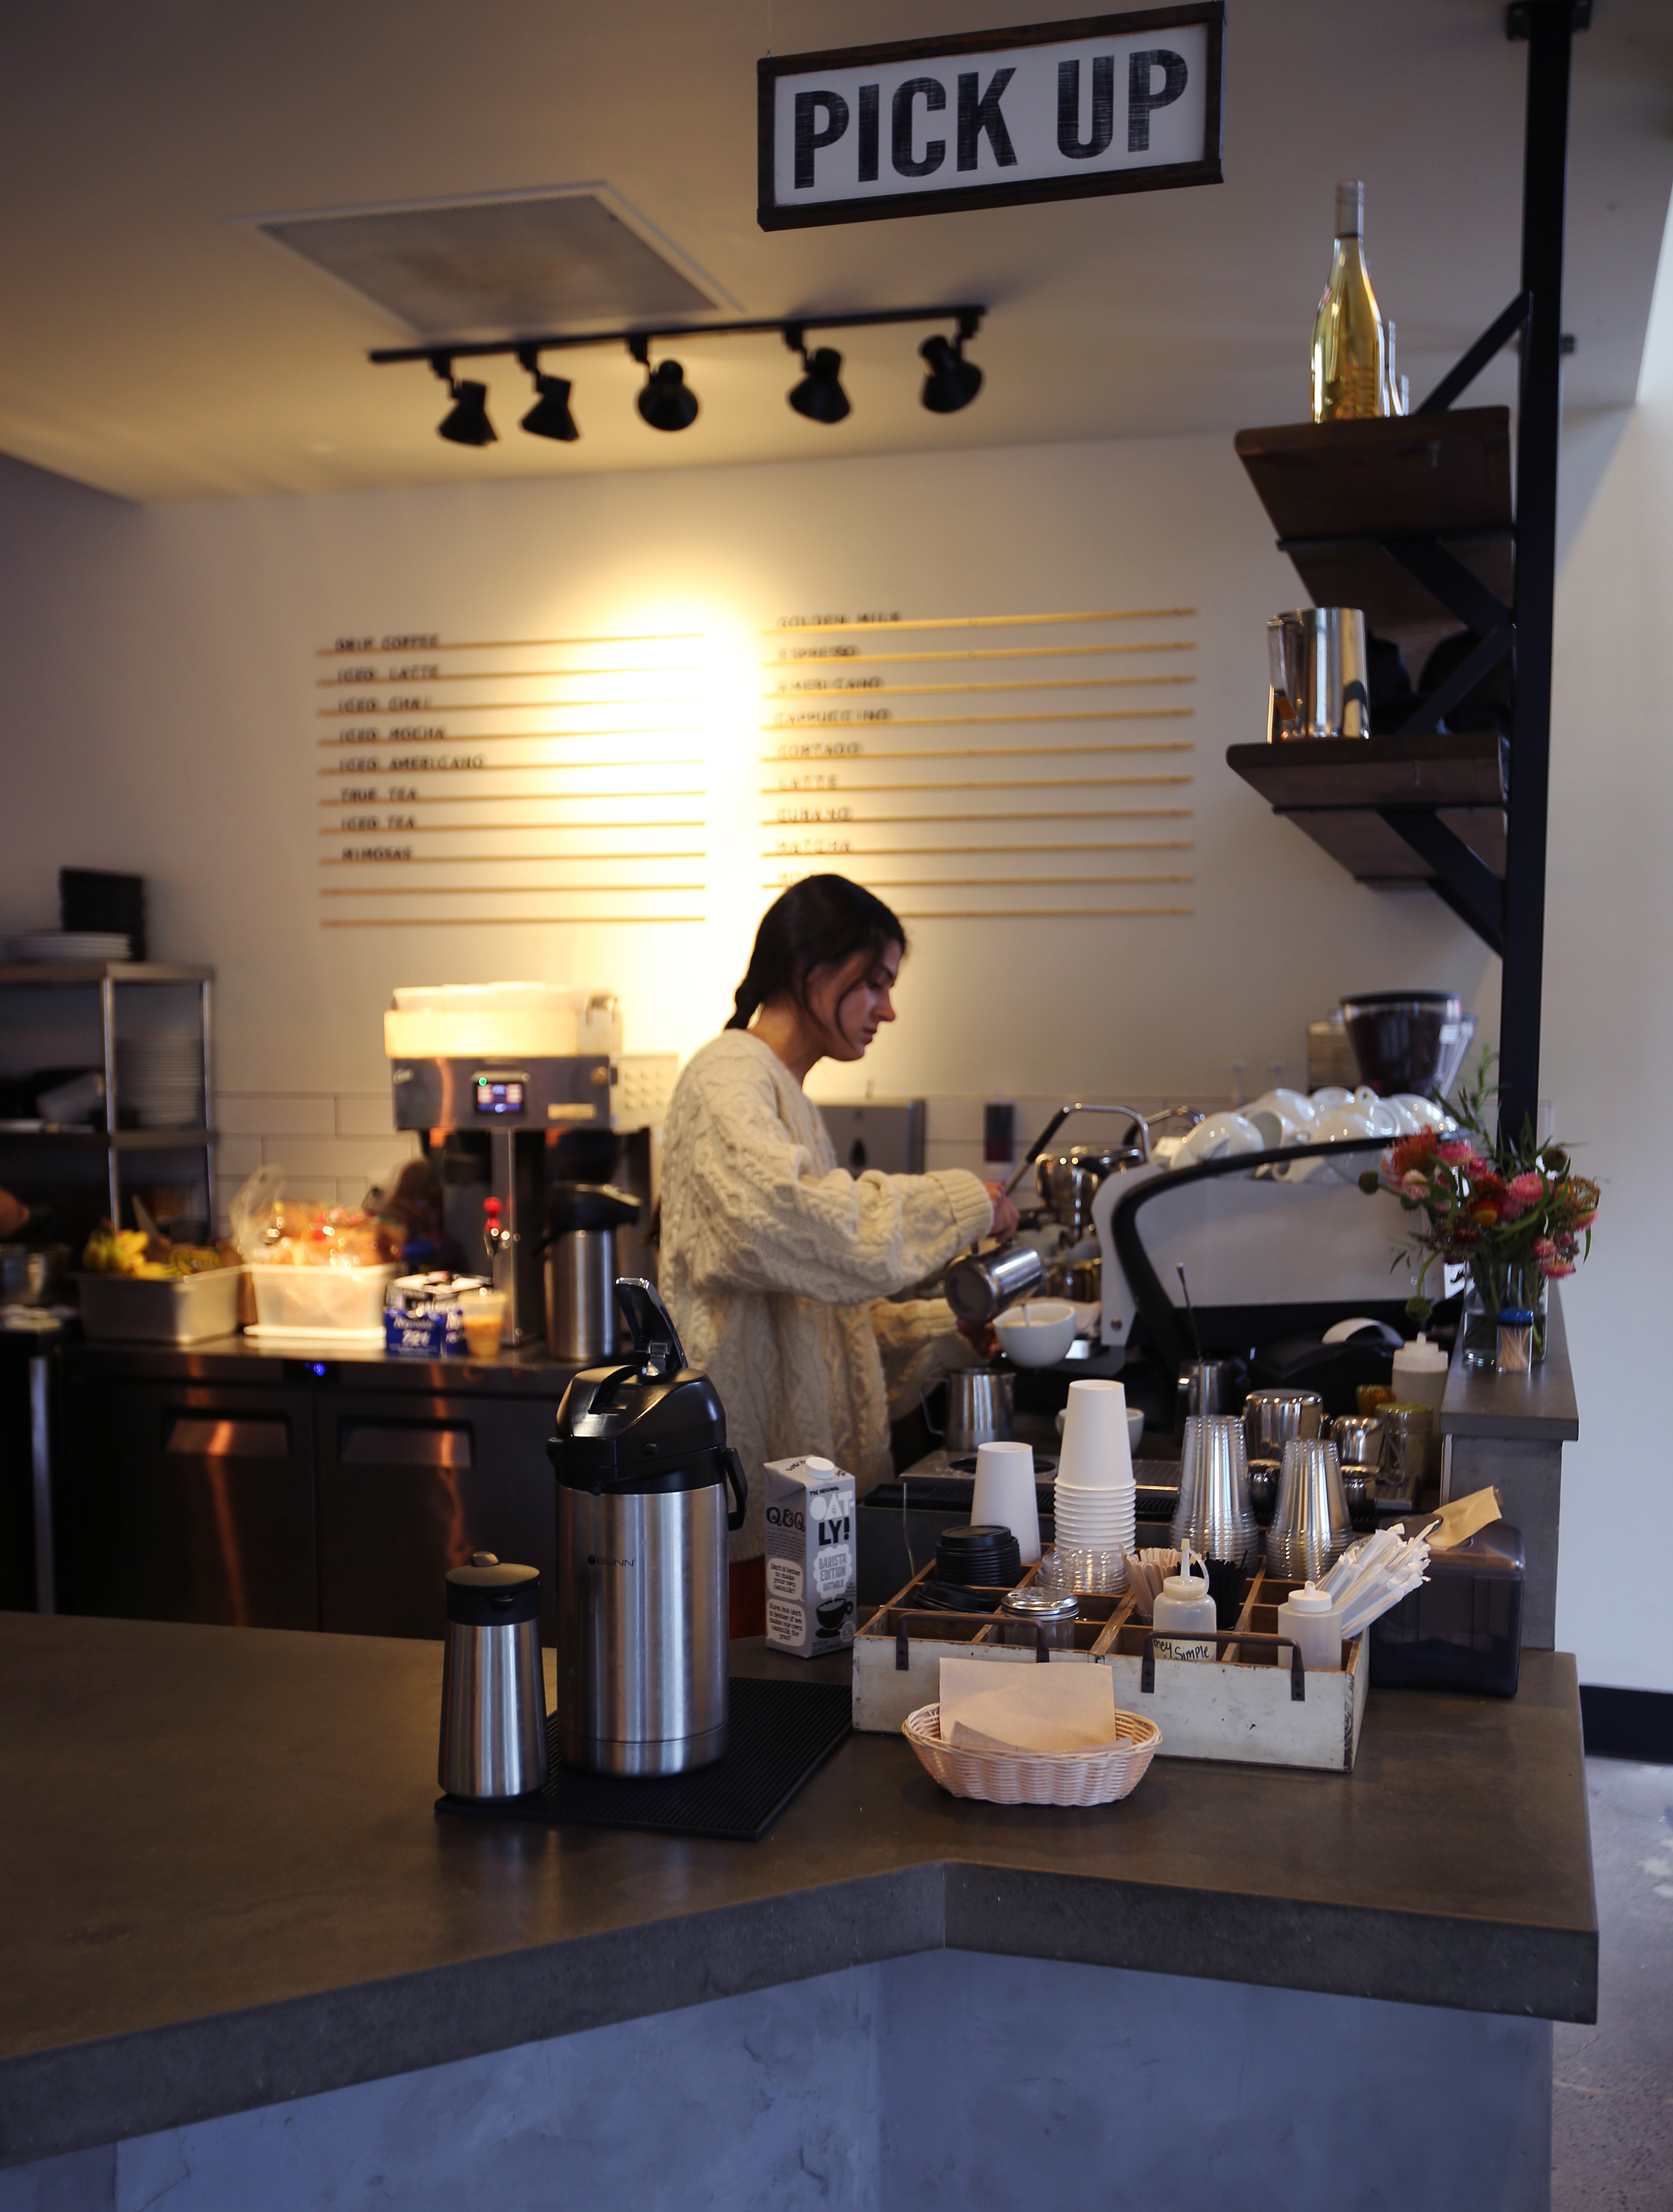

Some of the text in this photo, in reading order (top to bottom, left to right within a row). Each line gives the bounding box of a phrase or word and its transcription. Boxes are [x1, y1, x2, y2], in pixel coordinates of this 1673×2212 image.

[794, 49, 1188, 189] PICK UP
[777, 610, 901, 627] GOLDEN MILK
[335, 633, 439, 652] DRIP COFFEE
[338, 664, 439, 682] ICED LATTE
[776, 676, 884, 694] AMERICANO
[339, 695, 432, 713] ICED CHAI
[774, 708, 892, 725] CAPPUCCINO
[339, 725, 445, 744] ICED MOCHA
[339, 754, 484, 772] ICED AMERICANO
[779, 775, 837, 790] LATTE
[389, 786, 417, 801] TEA
[342, 814, 415, 831] ICED TEA
[342, 846, 412, 861] MIMOSAS
[766, 1506, 805, 1532] Q&Q
[818, 1517, 850, 1546] LY!
[596, 1558, 634, 1567] BUNN
[819, 1553, 846, 1569] BARISTA
[820, 1565, 845, 1582] EDITION
